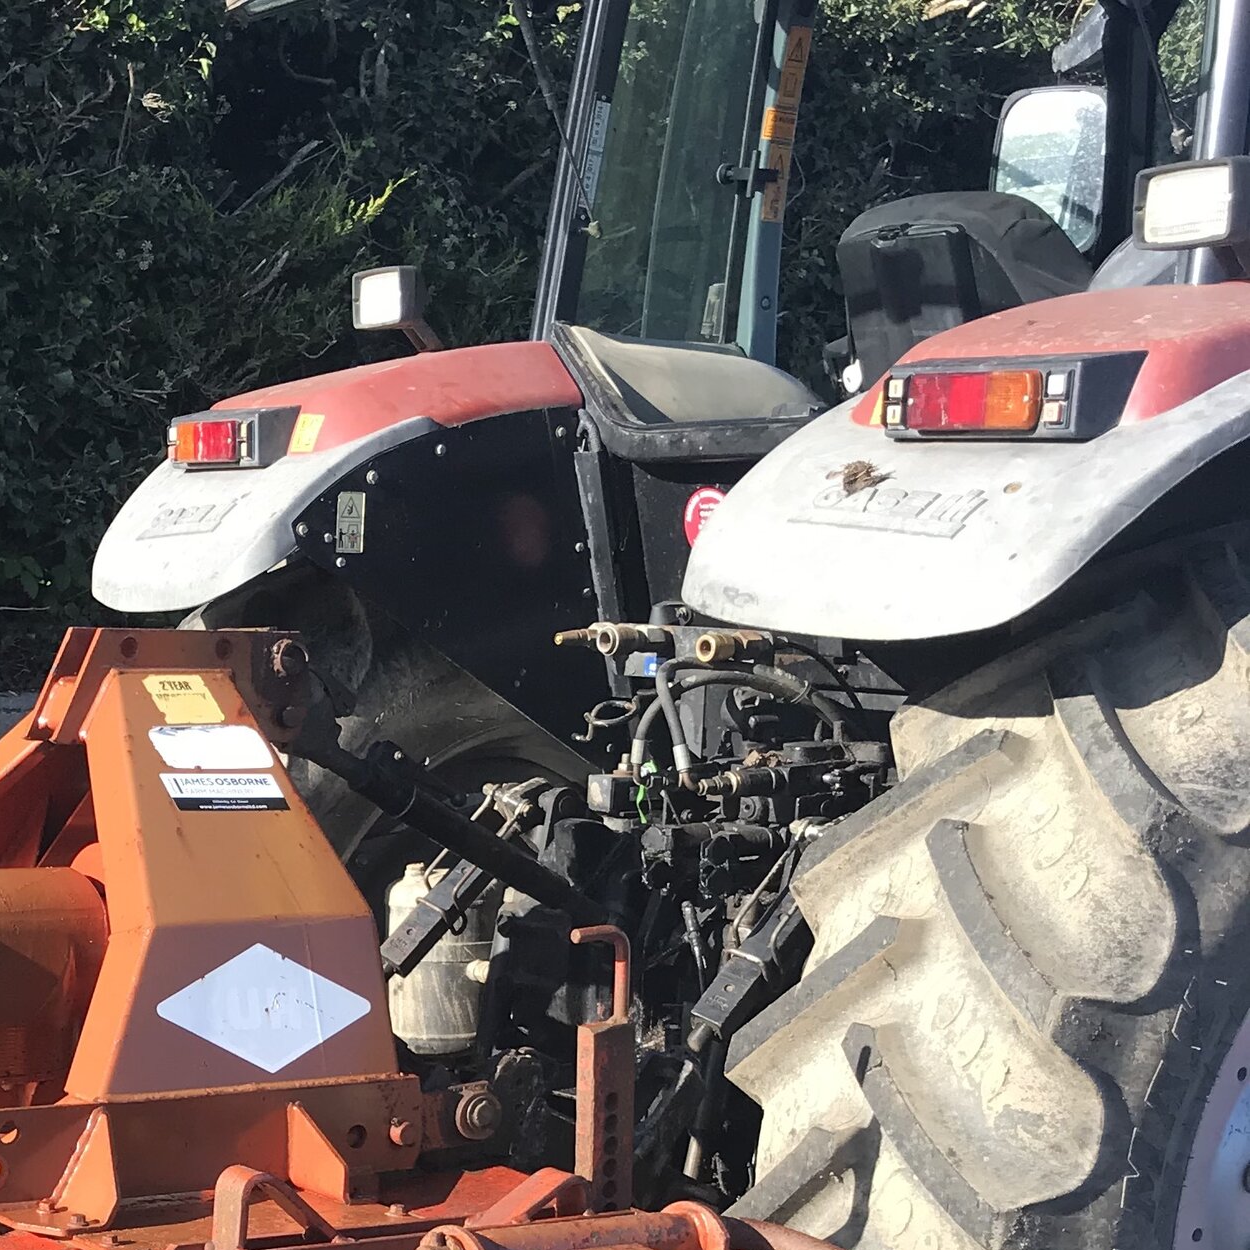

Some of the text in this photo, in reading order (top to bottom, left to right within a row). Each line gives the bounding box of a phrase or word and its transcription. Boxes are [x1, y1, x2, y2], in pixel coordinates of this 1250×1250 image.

[158, 680, 192, 691] 2 YEAR
[180, 777, 271, 787] JAMES OSBORNE
